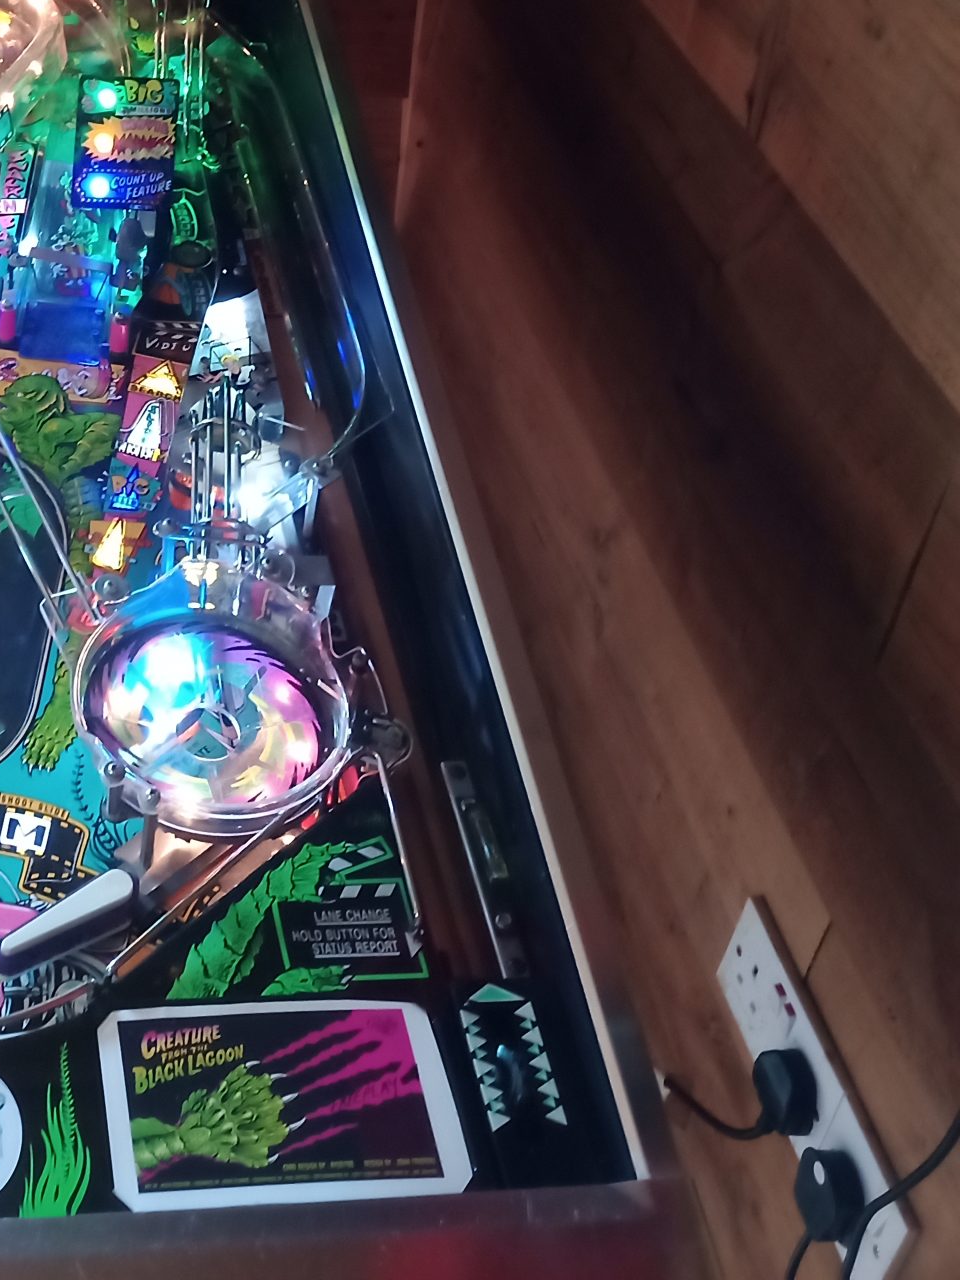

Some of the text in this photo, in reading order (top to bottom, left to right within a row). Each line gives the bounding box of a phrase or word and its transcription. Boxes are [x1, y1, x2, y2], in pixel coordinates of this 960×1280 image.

[125, 80, 163, 103] BIG
[110, 172, 165, 189] COUNT UP
[126, 180, 173, 200] FEATURE
[1, 794, 33, 808] SHOOT
[38, 803, 67, 818] SLIDE
[313, 908, 392, 921] LANE CHANGE
[291, 926, 396, 942] HOLD BUTTON FOR
[312, 940, 399, 954] STATUS REPORT
[141, 1024, 222, 1061] CREATURE
[132, 1044, 245, 1095] BLACK LAGOON
